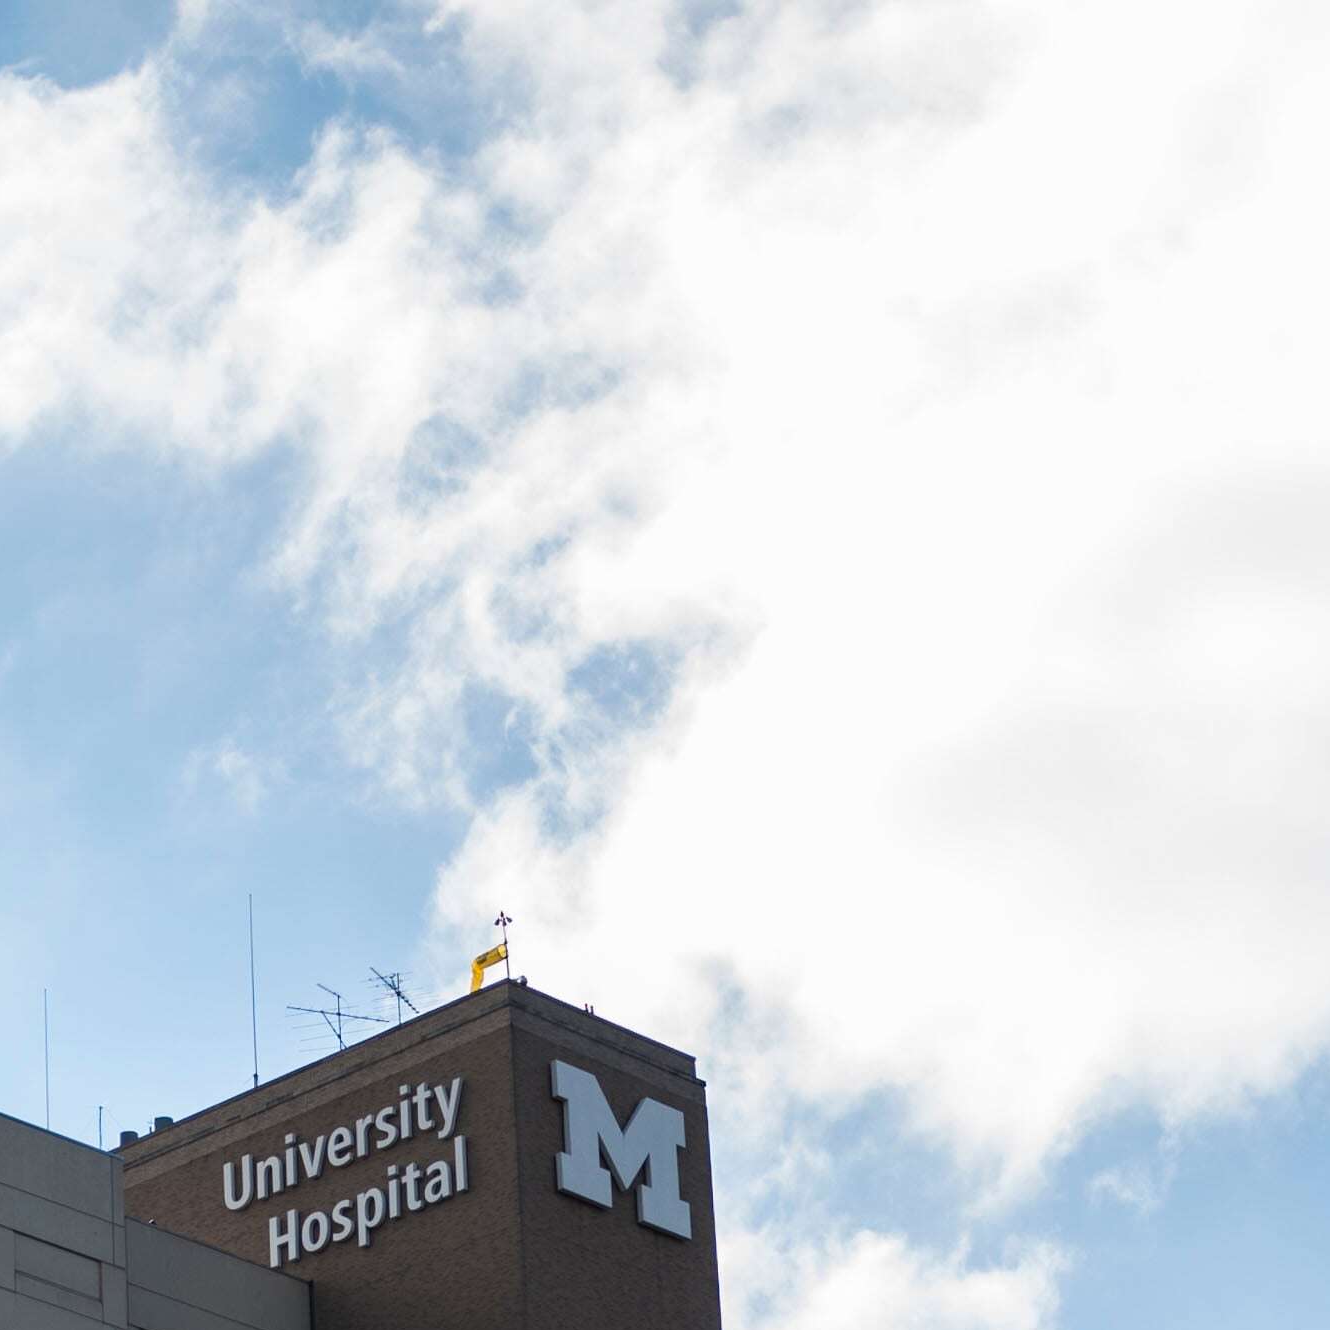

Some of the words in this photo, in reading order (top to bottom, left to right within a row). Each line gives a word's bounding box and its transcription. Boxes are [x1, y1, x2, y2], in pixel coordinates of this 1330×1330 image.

[221, 1077, 462, 1211] University
[268, 1135, 467, 1268] Hospital
[551, 1059, 692, 1240] M
